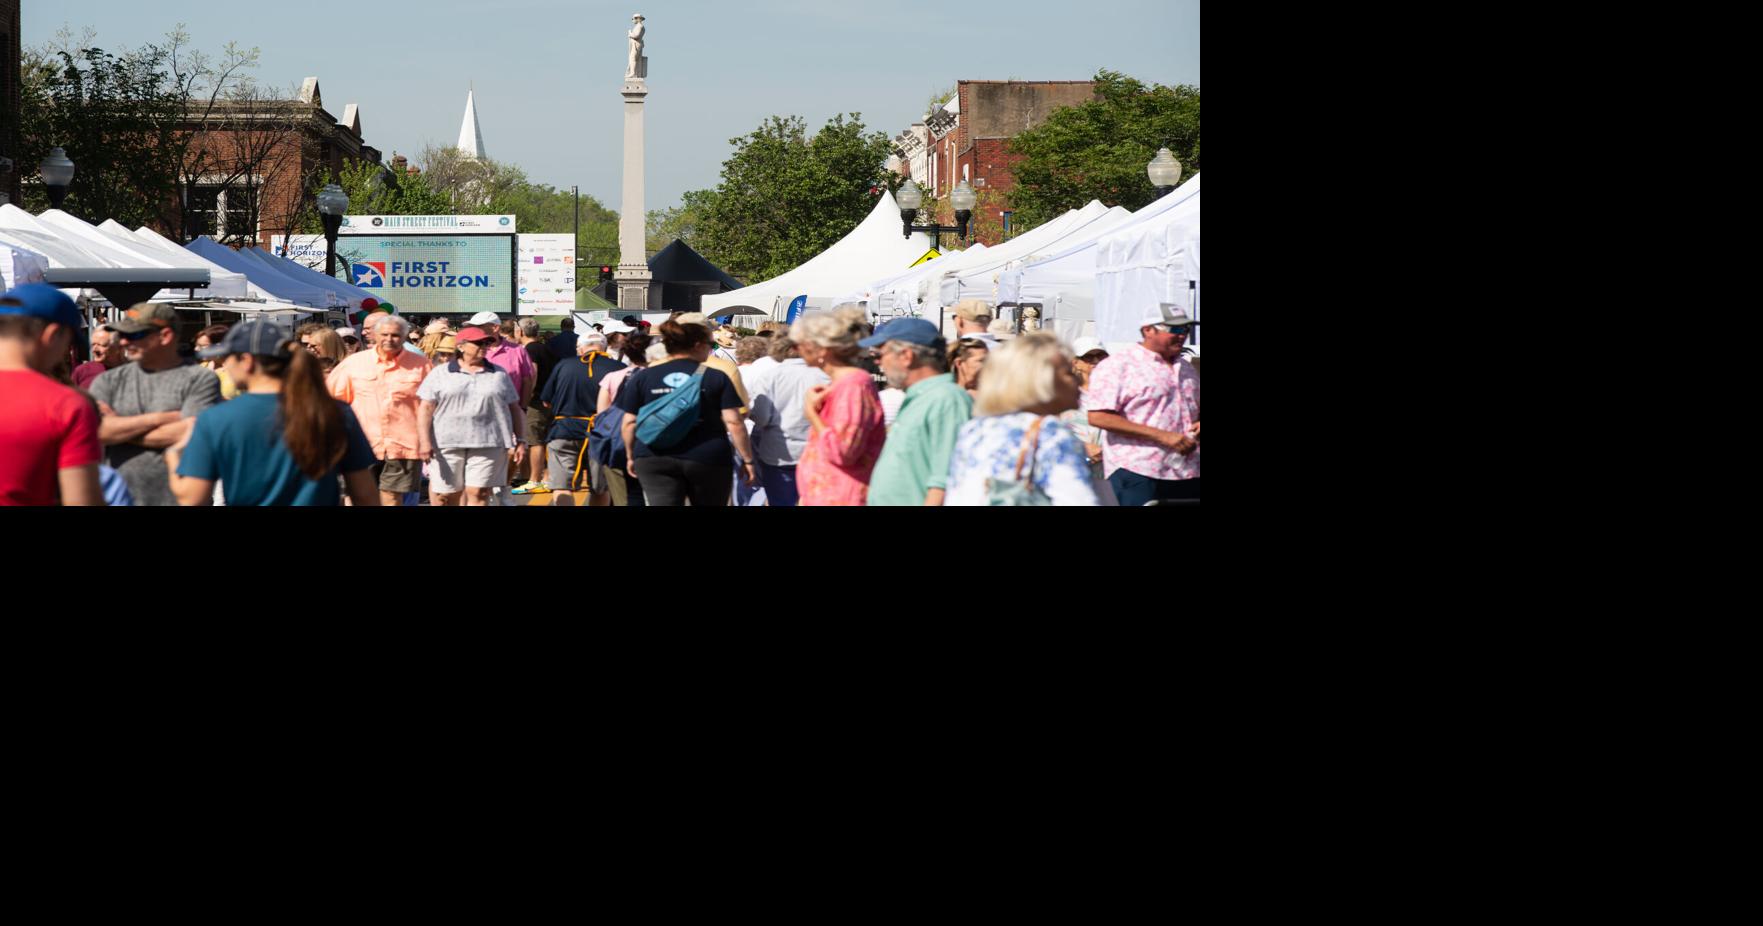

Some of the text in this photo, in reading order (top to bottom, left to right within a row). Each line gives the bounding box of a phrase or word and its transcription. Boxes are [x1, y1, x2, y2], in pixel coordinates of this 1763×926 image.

[402, 217, 426, 227] STREET
[428, 216, 457, 227] FESTIVAL
[391, 261, 450, 273] FIRST
